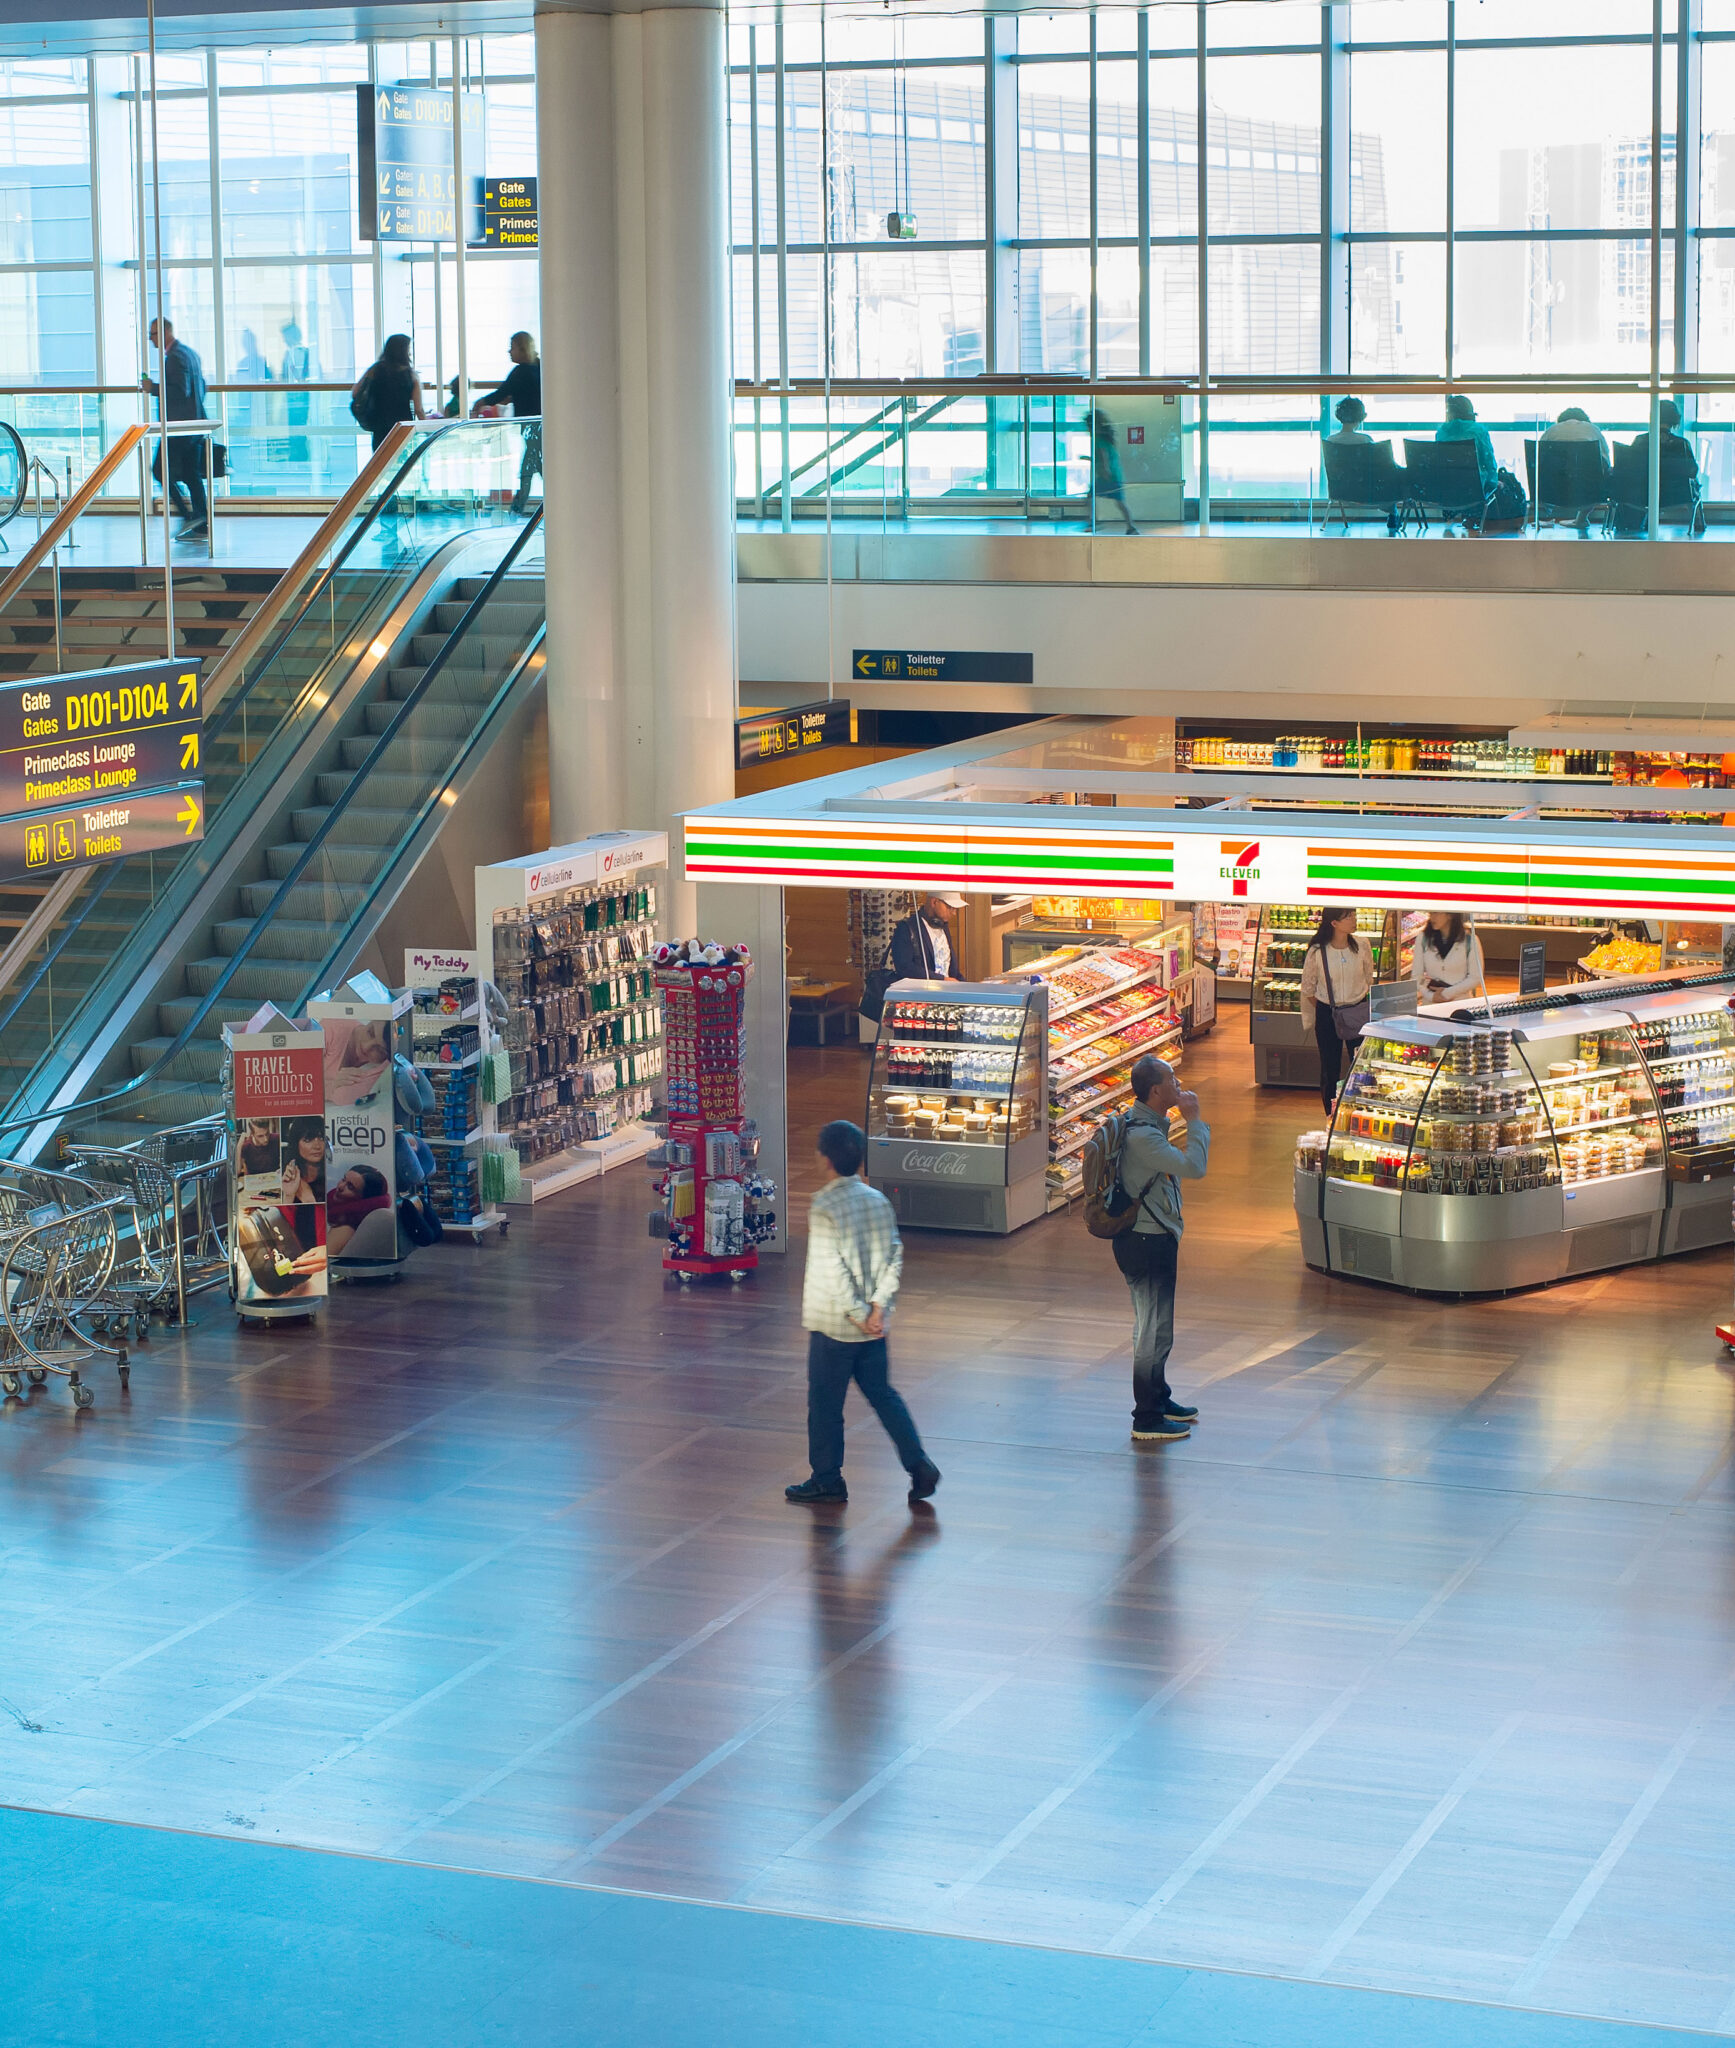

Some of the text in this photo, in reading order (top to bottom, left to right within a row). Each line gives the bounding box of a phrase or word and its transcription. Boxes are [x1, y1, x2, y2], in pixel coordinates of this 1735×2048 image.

[393, 91, 409, 104] Gate
[394, 107, 412, 120] Gates
[395, 169, 413, 181] Gates
[395, 184, 414, 197] Gates
[499, 182, 525, 194] Gate
[499, 196, 532, 208] Gates
[396, 206, 411, 219] Gate
[396, 222, 414, 234] Gates
[417, 209, 453, 235] D1-D4
[907, 654, 946, 665] Toiletter
[907, 666, 938, 677] Toilets
[22, 691, 51, 713] Gate
[66, 682, 169, 731] D101-D104
[23, 716, 59, 738] Gates
[801, 712, 826, 729] Toiletter
[802, 728, 822, 746] Toilets
[24, 743, 136, 776] Primeclass Lounge
[25, 767, 137, 802] Primeclass Lounge
[83, 809, 130, 833] Toiletter
[83, 835, 122, 857] Toilets
[413, 955, 469, 972] My Teddy
[243, 1056, 293, 1076] TRAVEL
[245, 1073, 313, 1095] PRODUCTS
[336, 1115, 370, 1126] restful
[902, 1149, 970, 1175] Coca-Cola
